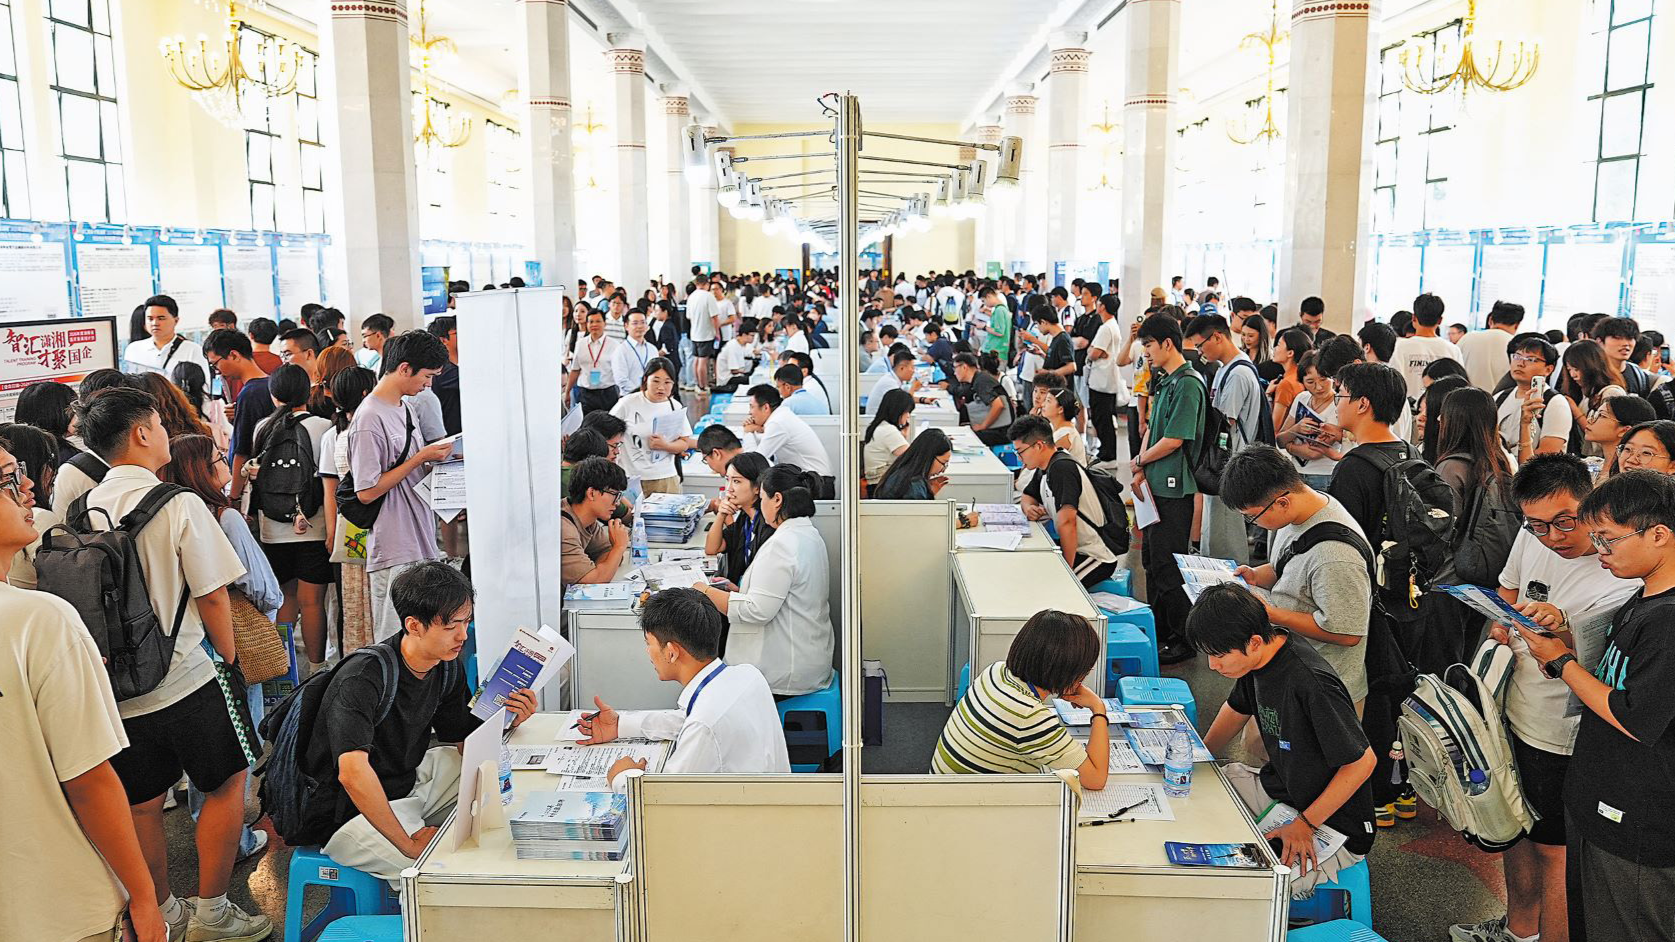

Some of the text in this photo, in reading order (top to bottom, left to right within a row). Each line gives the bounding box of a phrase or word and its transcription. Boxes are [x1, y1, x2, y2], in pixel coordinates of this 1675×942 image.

[2, 328, 66, 355] 智汇潇湘
[37, 346, 92, 370] 才聚国企
